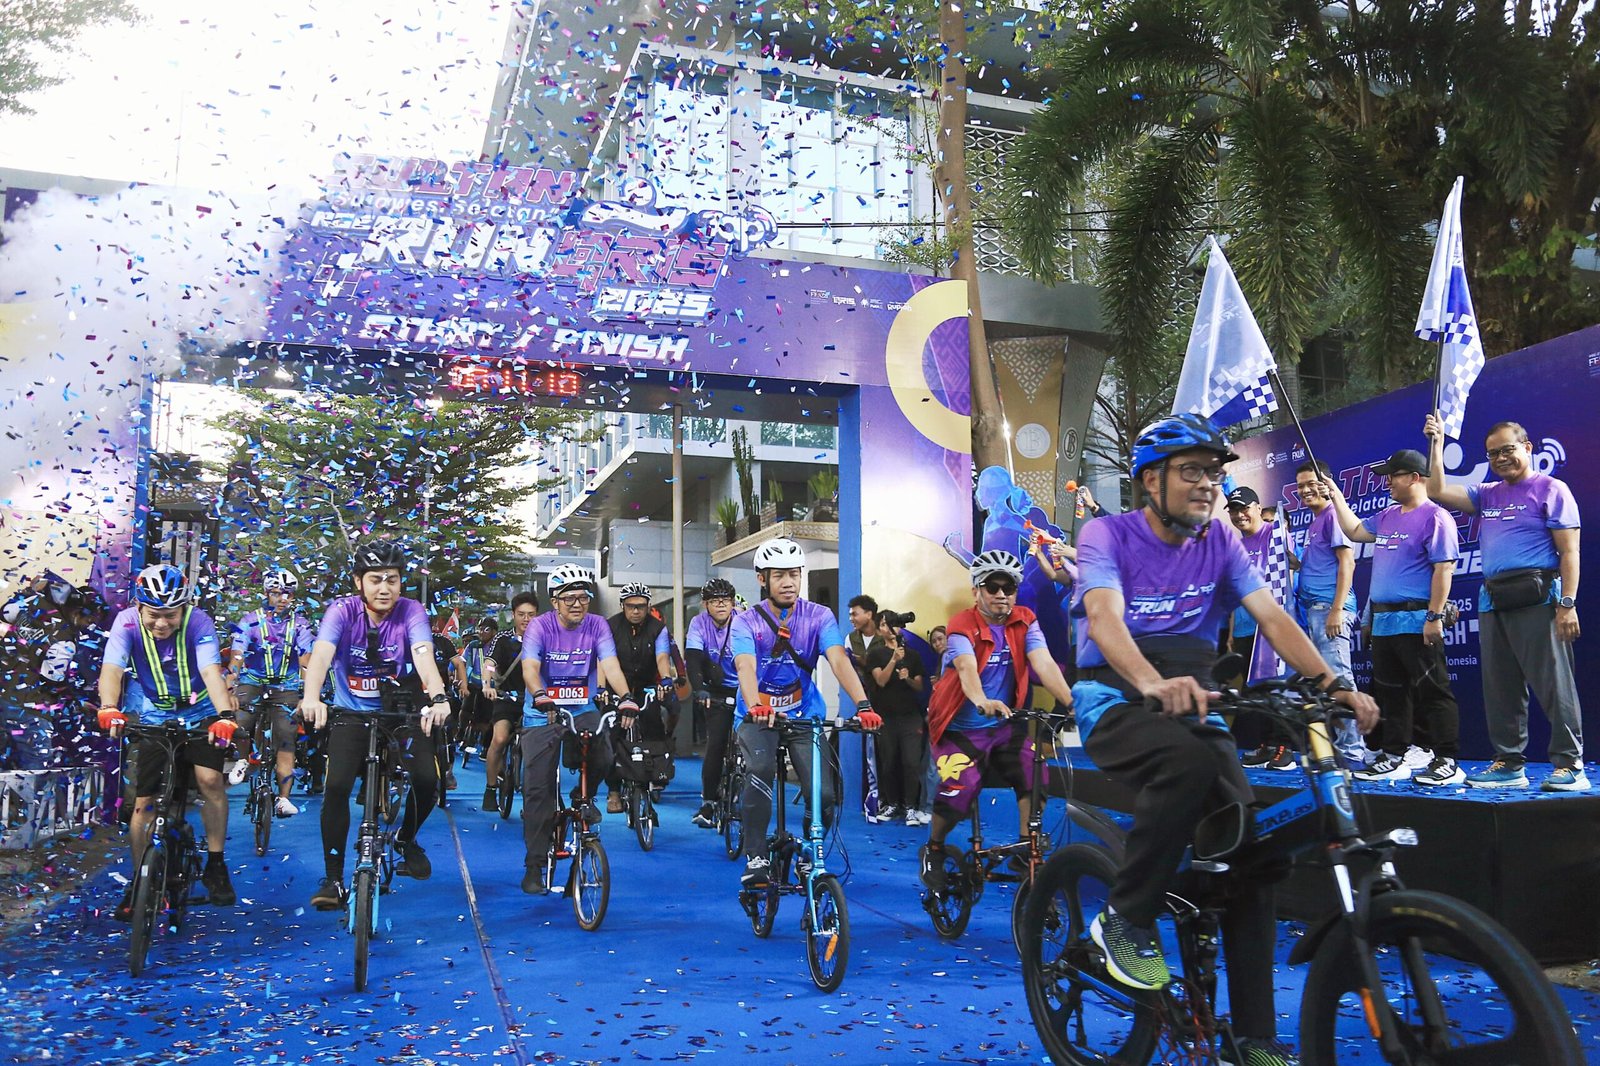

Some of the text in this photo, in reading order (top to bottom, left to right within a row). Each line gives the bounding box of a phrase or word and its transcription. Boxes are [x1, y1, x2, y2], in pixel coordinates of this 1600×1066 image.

[361, 215, 557, 274] RUN
[594, 288, 714, 317] 2025
[552, 328, 690, 361] FINISH
[1140, 600, 1176, 614] RUN
[559, 687, 584, 698] 0063
[770, 694, 794, 706] 0121
